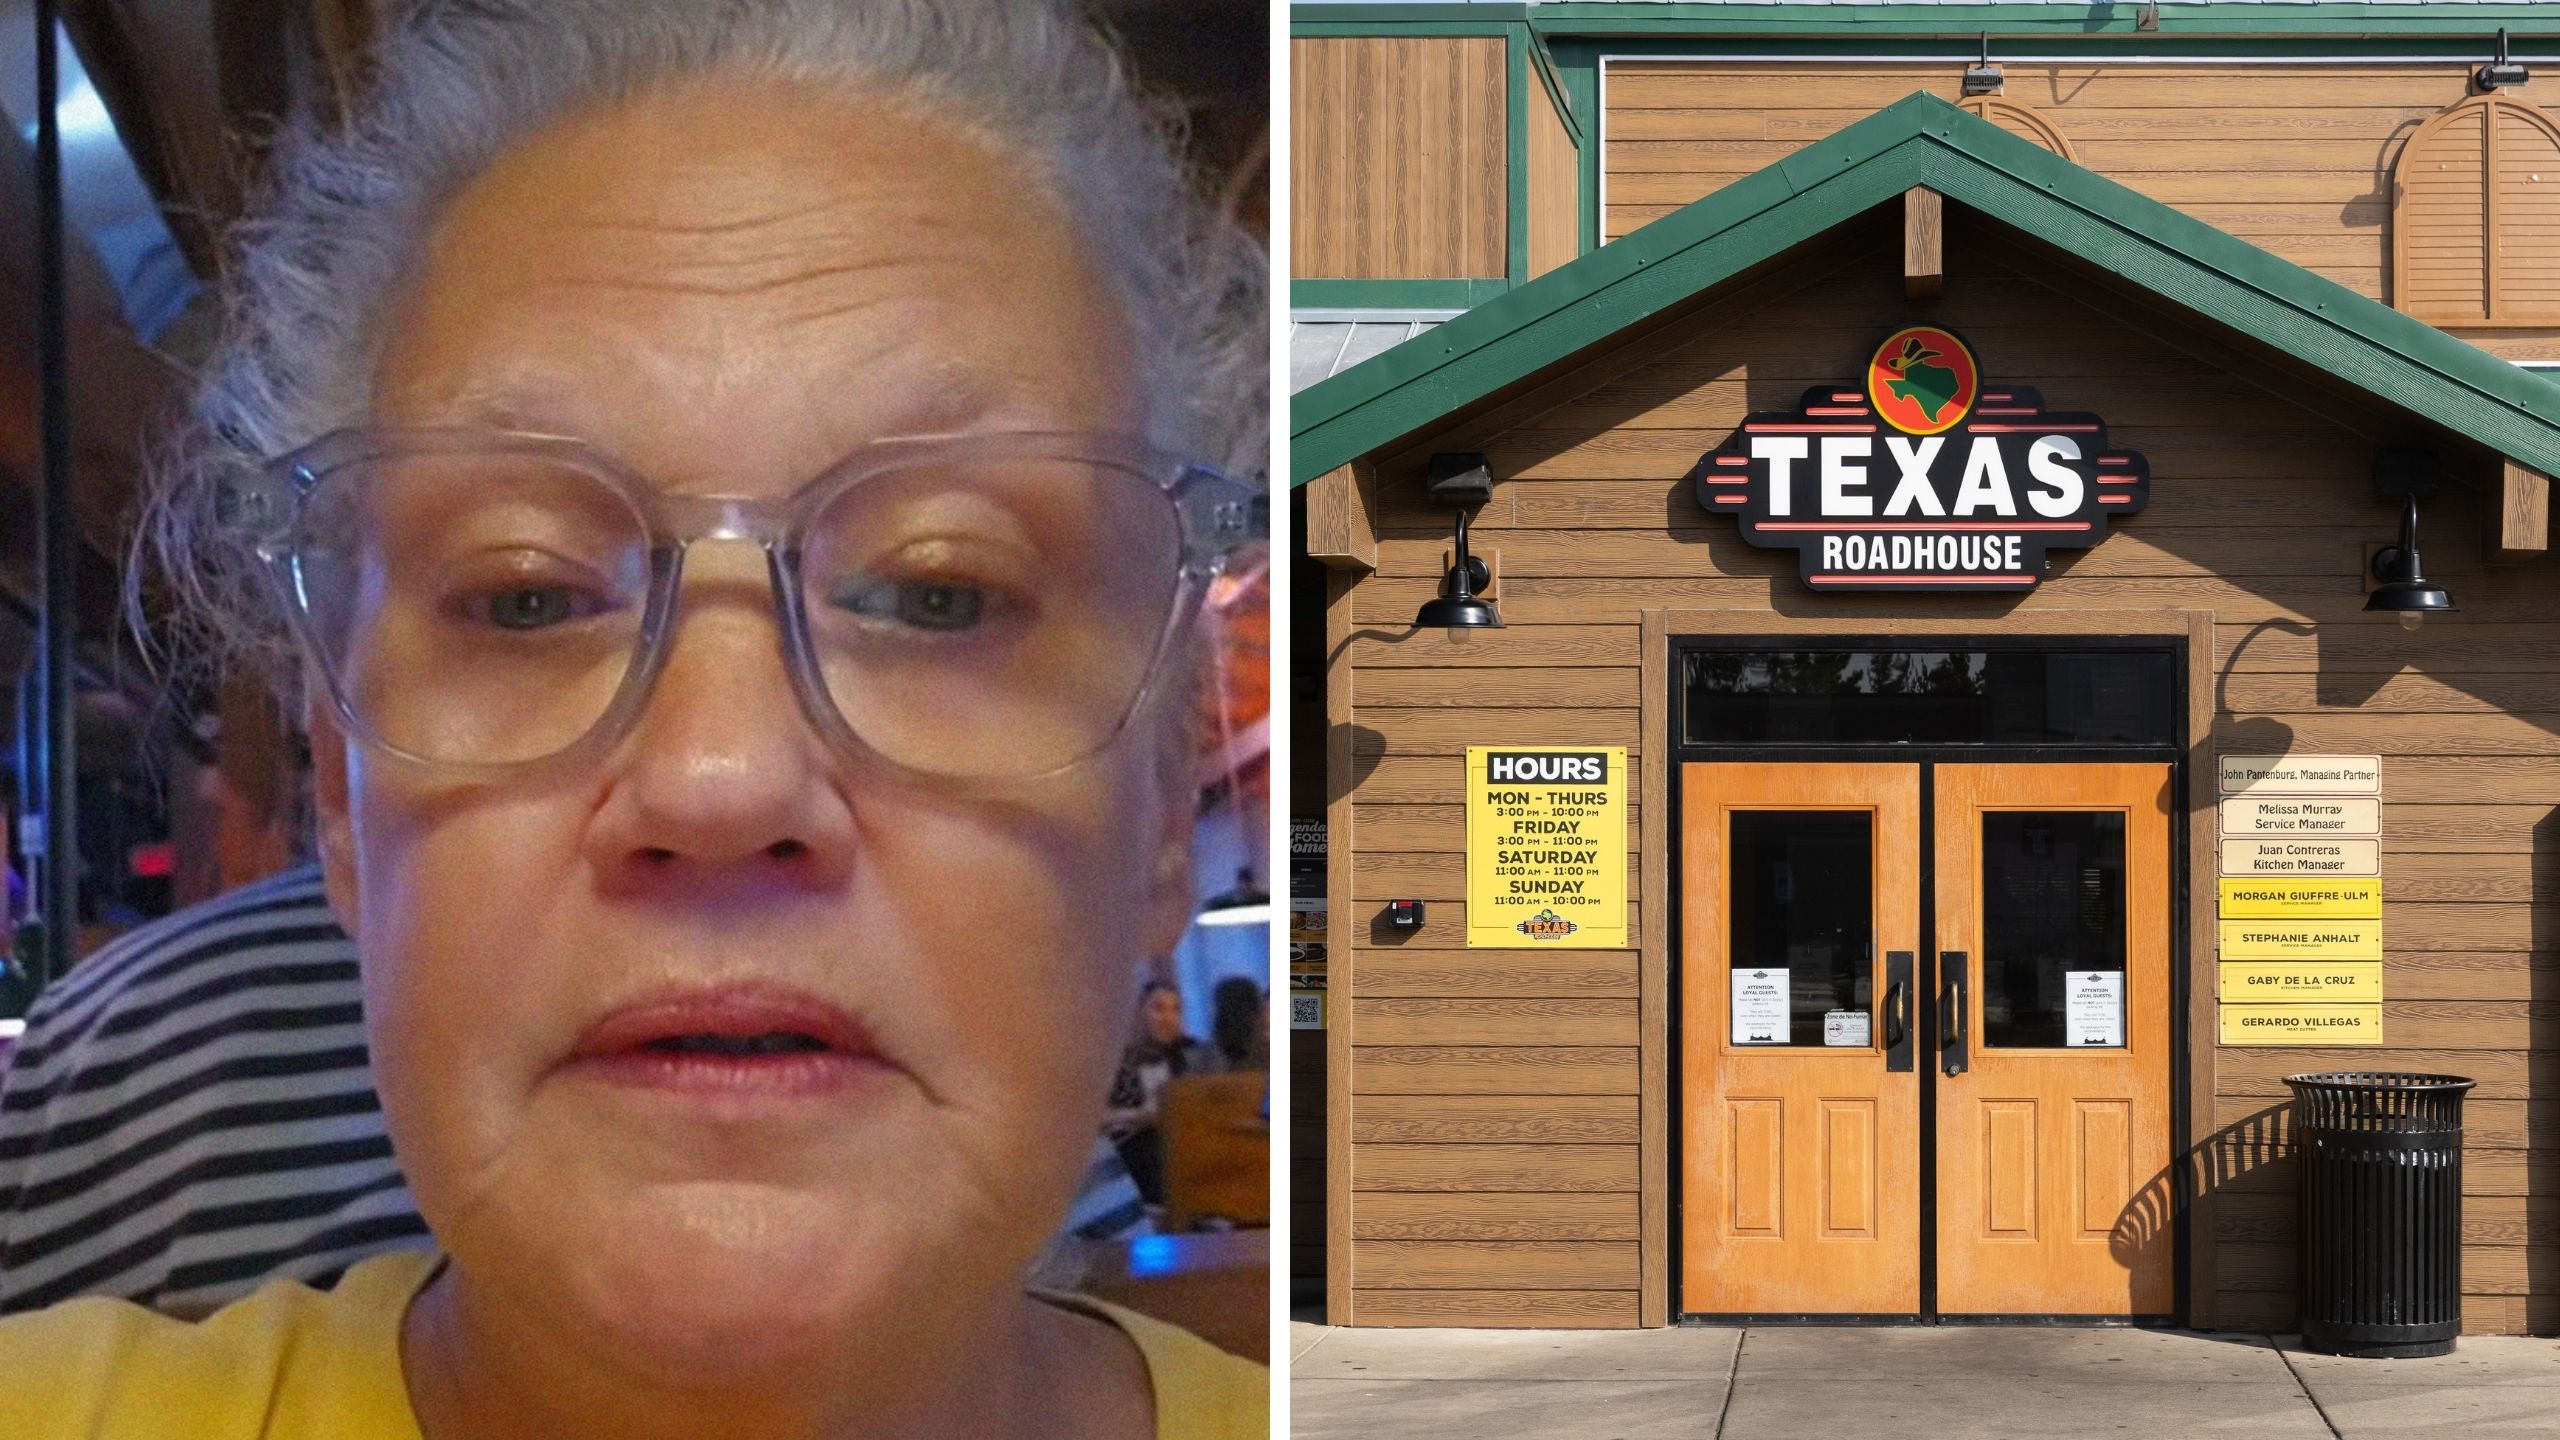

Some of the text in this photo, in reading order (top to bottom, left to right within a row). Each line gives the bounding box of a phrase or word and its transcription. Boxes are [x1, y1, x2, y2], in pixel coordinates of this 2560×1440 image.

[1751, 434, 2084, 518] TEXAS
[1823, 535, 2021, 570] ROADHOUSE
[1492, 757, 1602, 780] HOURS
[2224, 769, 2244, 780] John
[2300, 769, 2341, 780] Managing
[2343, 769, 2376, 781] Partner
[1487, 791, 1530, 805] MON
[1546, 791, 1608, 806] THURS
[1496, 807, 1524, 817] 3:00
[1551, 807, 1584, 817] 10:00
[2258, 803, 2343, 815] Melissa Murray
[1513, 820, 1581, 834] FRIDAY
[2255, 818, 2346, 830] Service Manager
[1497, 836, 1524, 846] 3:00
[1552, 836, 1583, 846] 11:00
[2257, 844, 2341, 856] Juan Contreras
[1498, 850, 1598, 864] SATURDAY
[2253, 859, 2346, 870] Kitchen Manager
[1495, 866, 1525, 876] 11:00
[1553, 866, 1583, 876] 11:00
[1509, 880, 1585, 894] SUNDAY
[1494, 896, 1525, 905] 11:00
[1552, 896, 1586, 905] 10:00
[2233, 891, 2286, 901] MORGAN
[1525, 921, 1569, 934] TEXAS
[2242, 933, 2361, 943] STEPHANIE ANHALT
[2247, 976, 2355, 985] GABY DE LA CRUZ
[2241, 1017, 2361, 1027] GERARDO VILLEGAS
